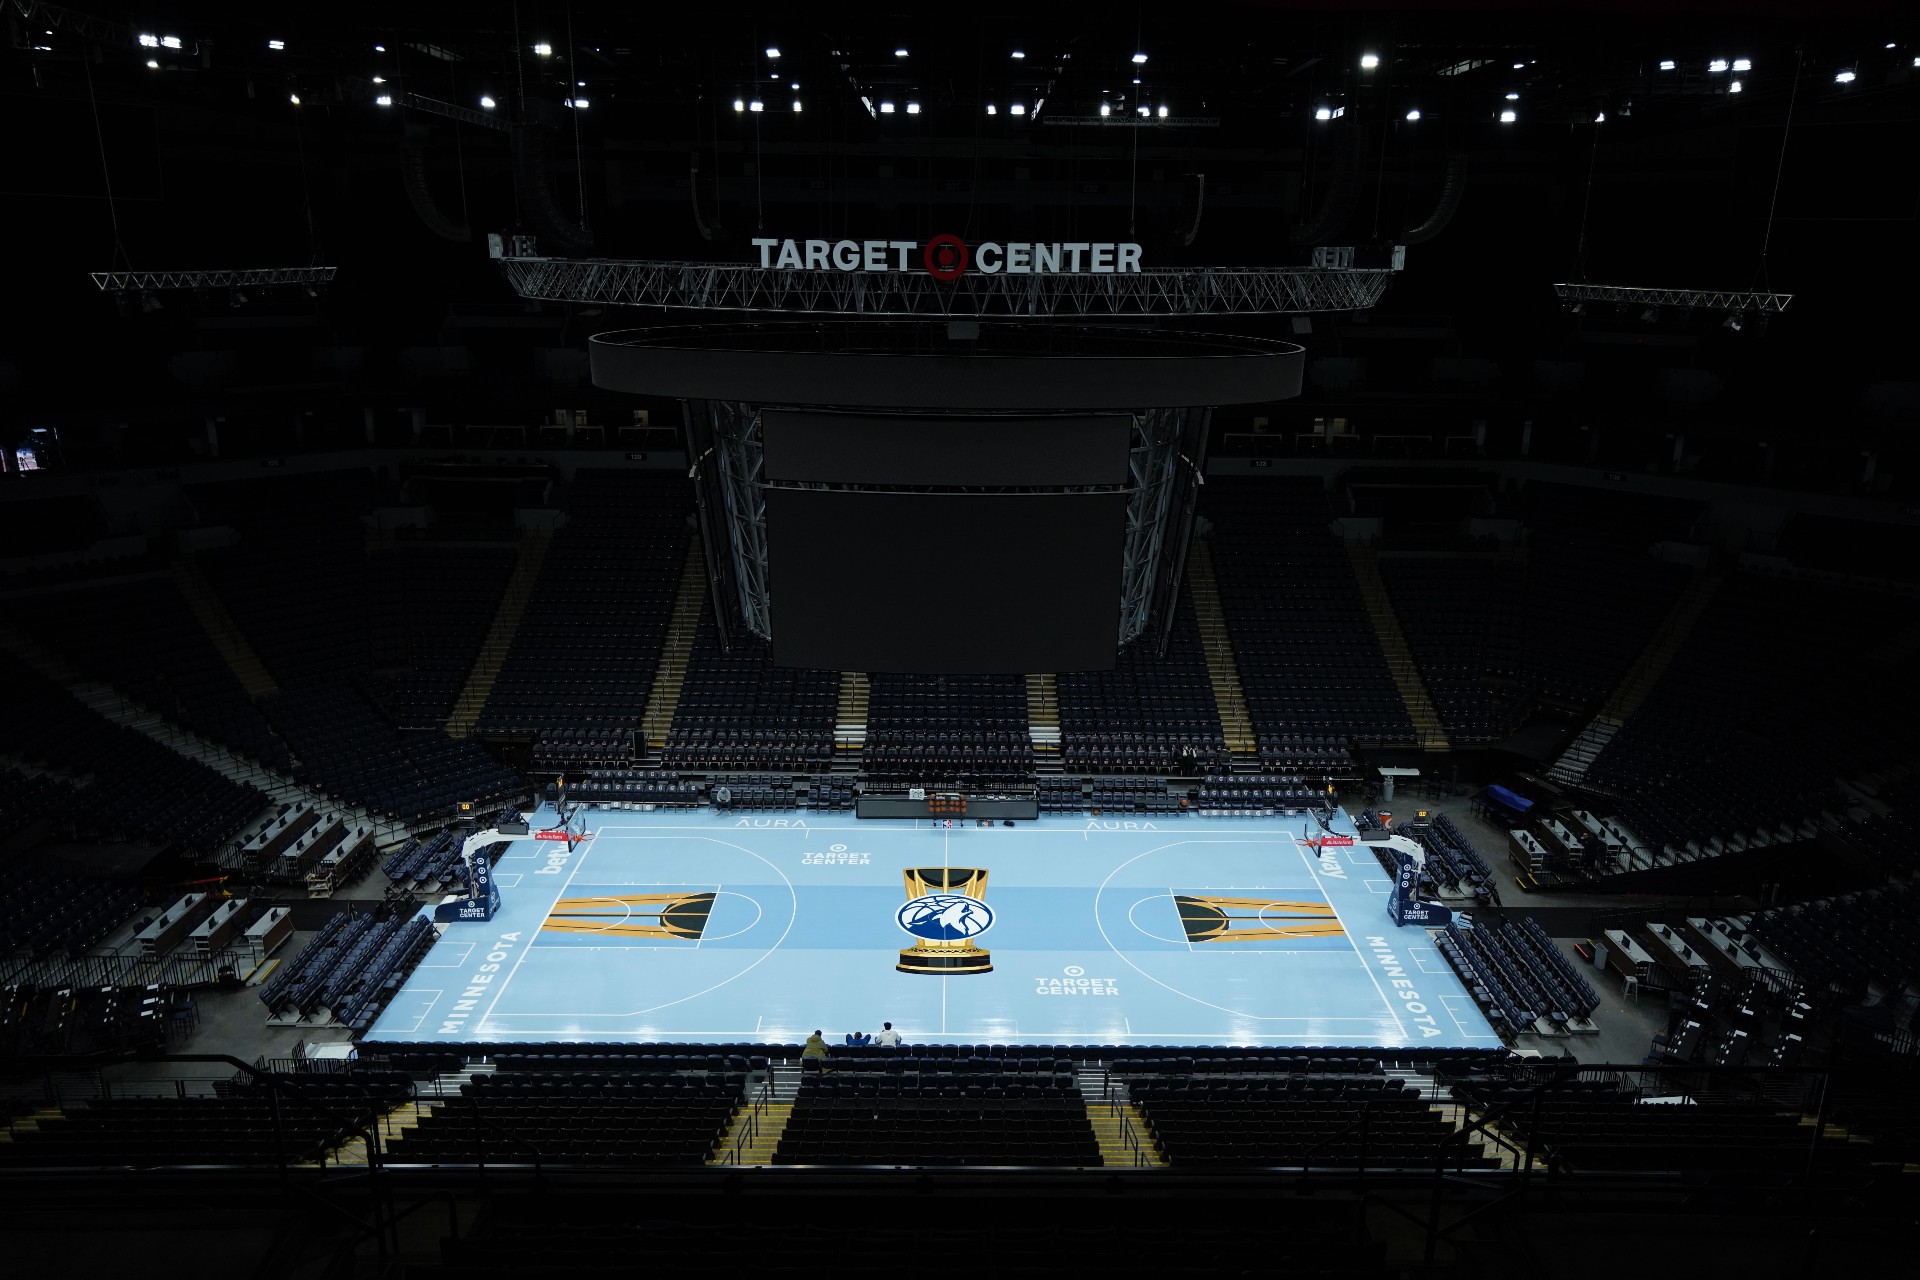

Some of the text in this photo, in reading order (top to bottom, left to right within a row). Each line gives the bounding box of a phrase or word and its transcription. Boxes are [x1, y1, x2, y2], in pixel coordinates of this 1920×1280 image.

[752, 238, 1143, 274] TARGET CENTER
[437, 931, 521, 1033] MINNESOTA
[1035, 978, 1117, 986] TARGET
[1036, 986, 1119, 995] CENTER
[1365, 936, 1442, 1038] MINNESOTA
